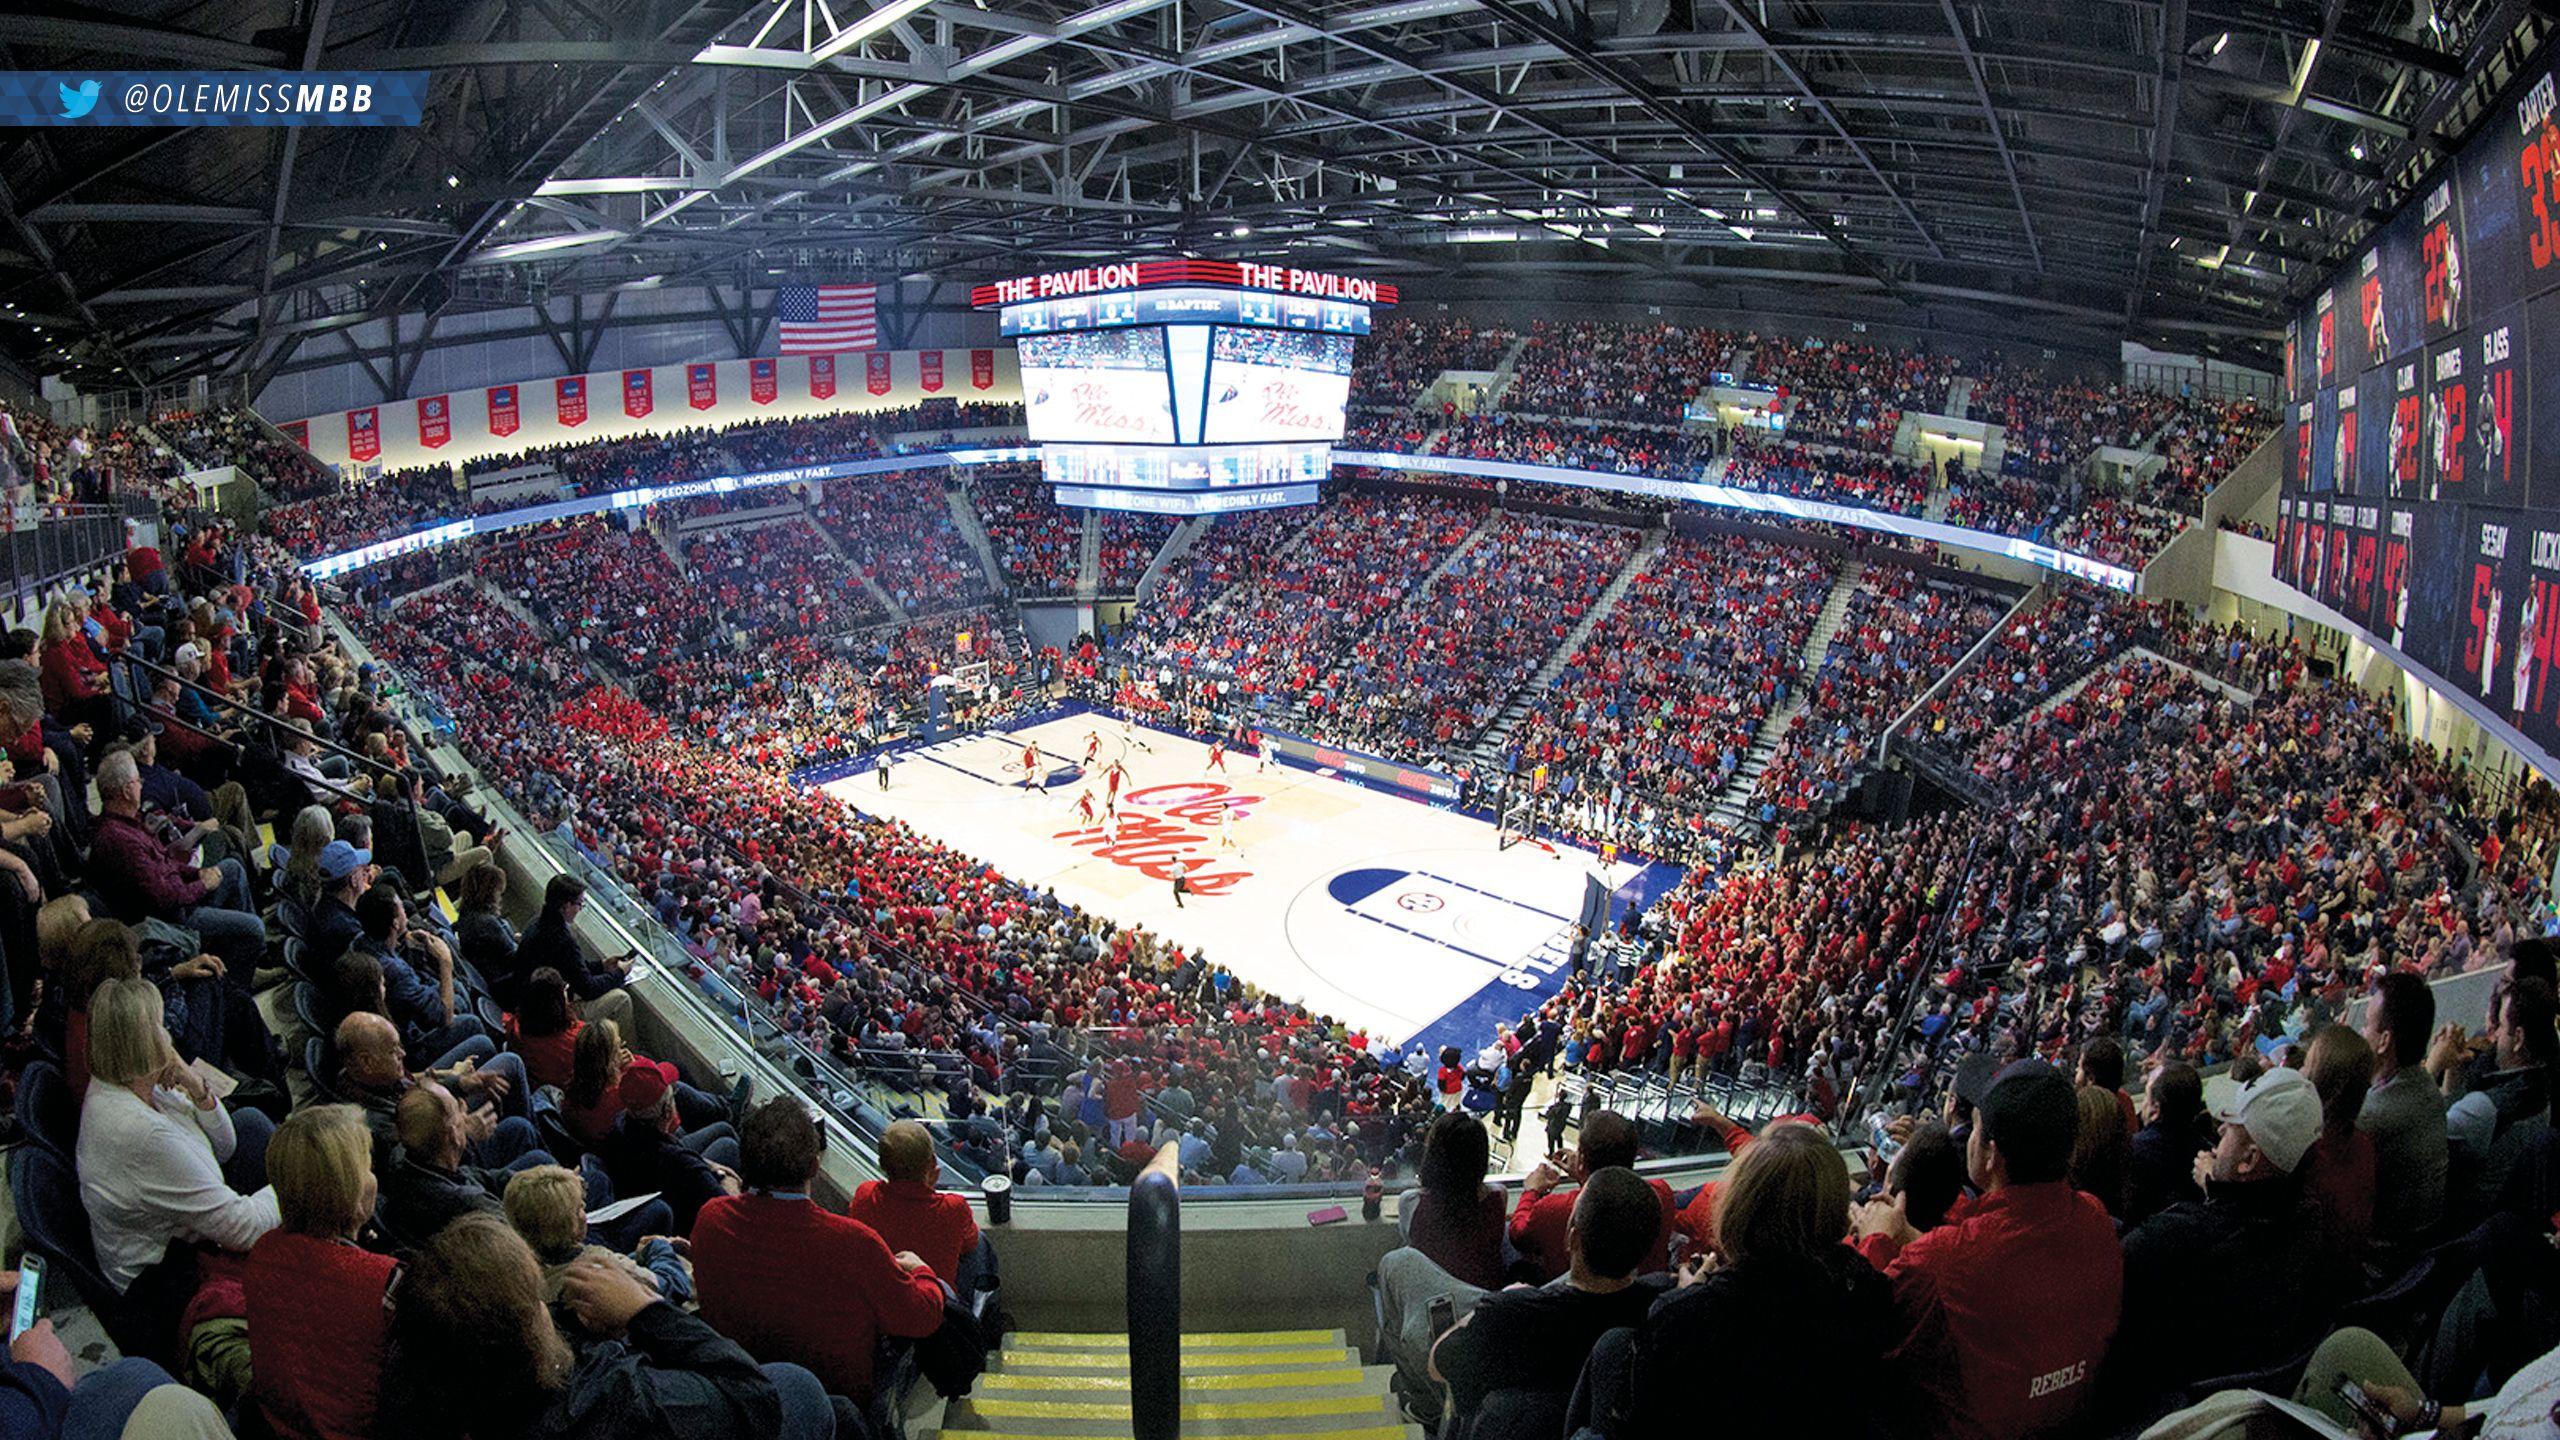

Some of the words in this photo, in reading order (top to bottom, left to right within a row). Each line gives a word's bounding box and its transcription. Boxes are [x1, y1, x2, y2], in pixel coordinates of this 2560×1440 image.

[2517, 71, 2557, 136] CARTER
[995, 276, 1034, 303] THE
[1040, 262, 1138, 298] PAVILION
[1237, 262, 1284, 290] THE
[1289, 268, 1377, 303] PAVILION
[2482, 326, 2509, 365] GLASS
[2495, 368, 2512, 481] 4
[742, 469, 803, 488] INCREDIBLY
[805, 467, 834, 480] FAST.
[1261, 491, 1286, 504] FAST.
[2480, 523, 2508, 559] SESAY
[2464, 562, 2492, 674] 5
[2029, 1360, 2087, 1399] REBELS
